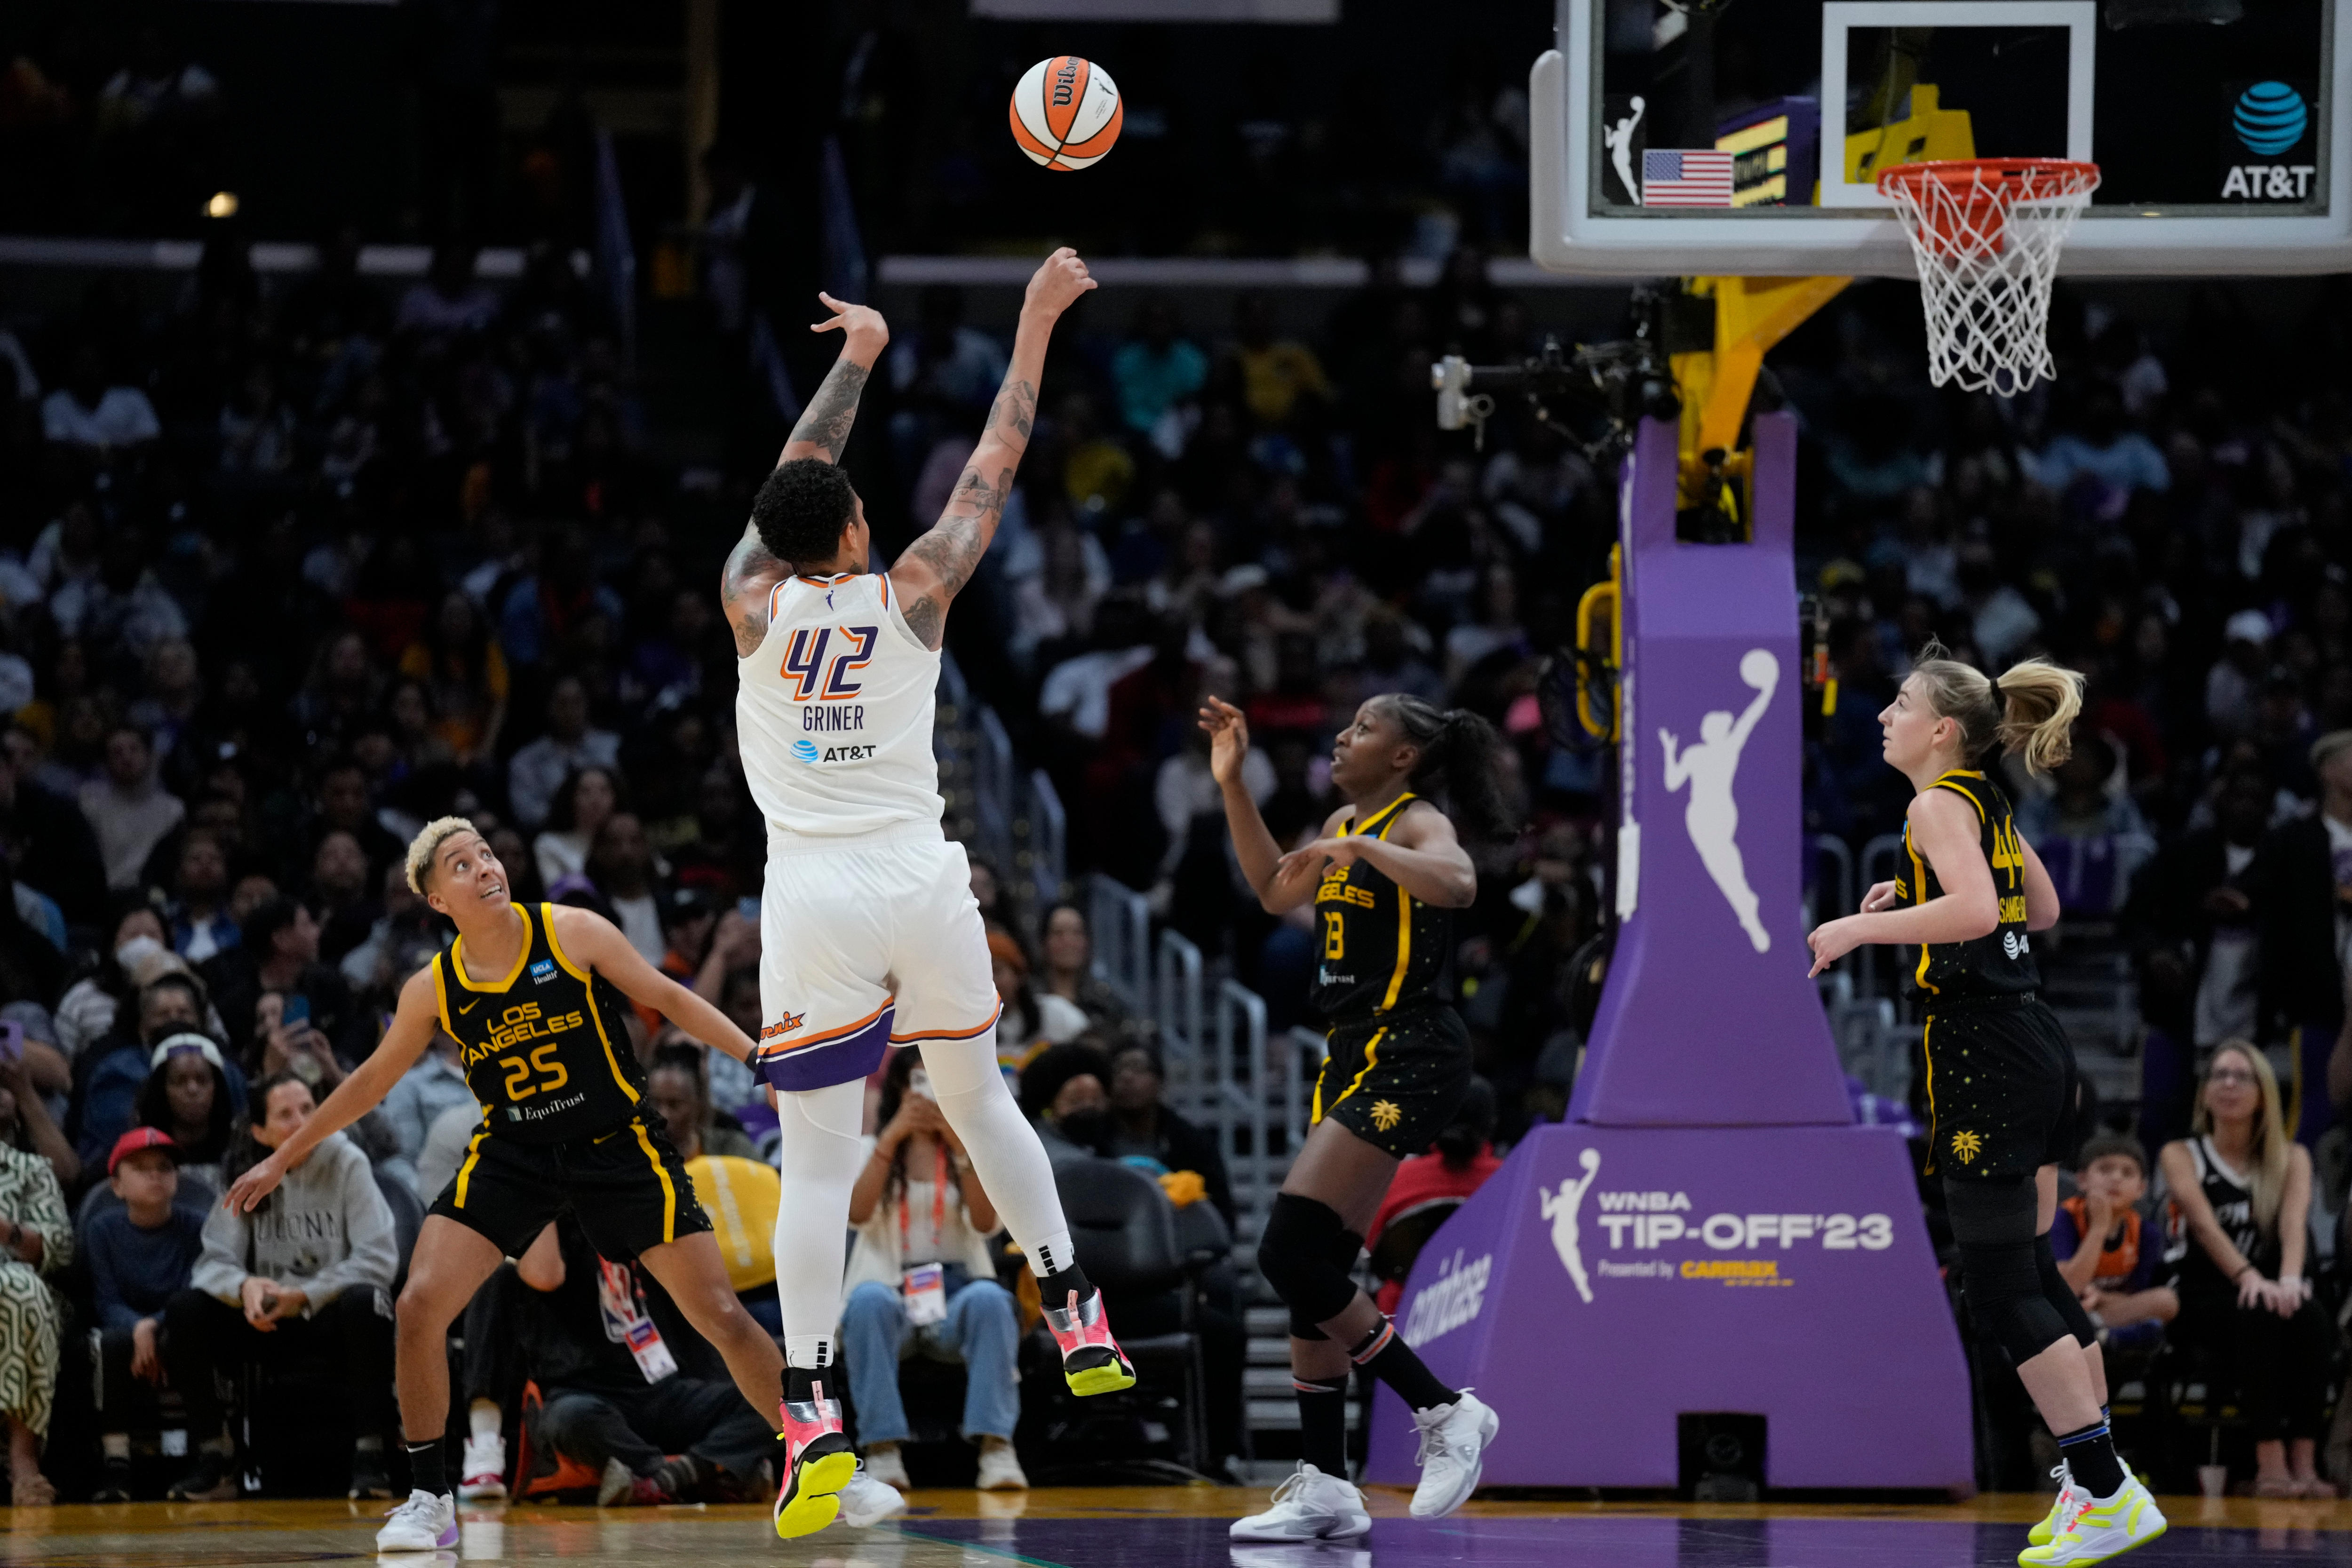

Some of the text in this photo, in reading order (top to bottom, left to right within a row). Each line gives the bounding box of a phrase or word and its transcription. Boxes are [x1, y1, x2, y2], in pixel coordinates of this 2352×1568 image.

[1052, 56, 1081, 107] Wilson
[2221, 165, 2315, 199] AT&T
[780, 626, 879, 701] 42
[803, 705, 864, 732] GRINER
[823, 745, 877, 763] AT&T
[532, 962, 551, 974] UCLA
[533, 970, 558, 986] Health
[486, 1001, 541, 1035] LOS
[468, 1010, 584, 1067] ANGELES
[498, 1042, 568, 1101] 25
[525, 1091, 586, 1121] EquiTrust
[1597, 1191, 1692, 1211] WNBA
[1597, 1258, 1657, 1278] Presented
